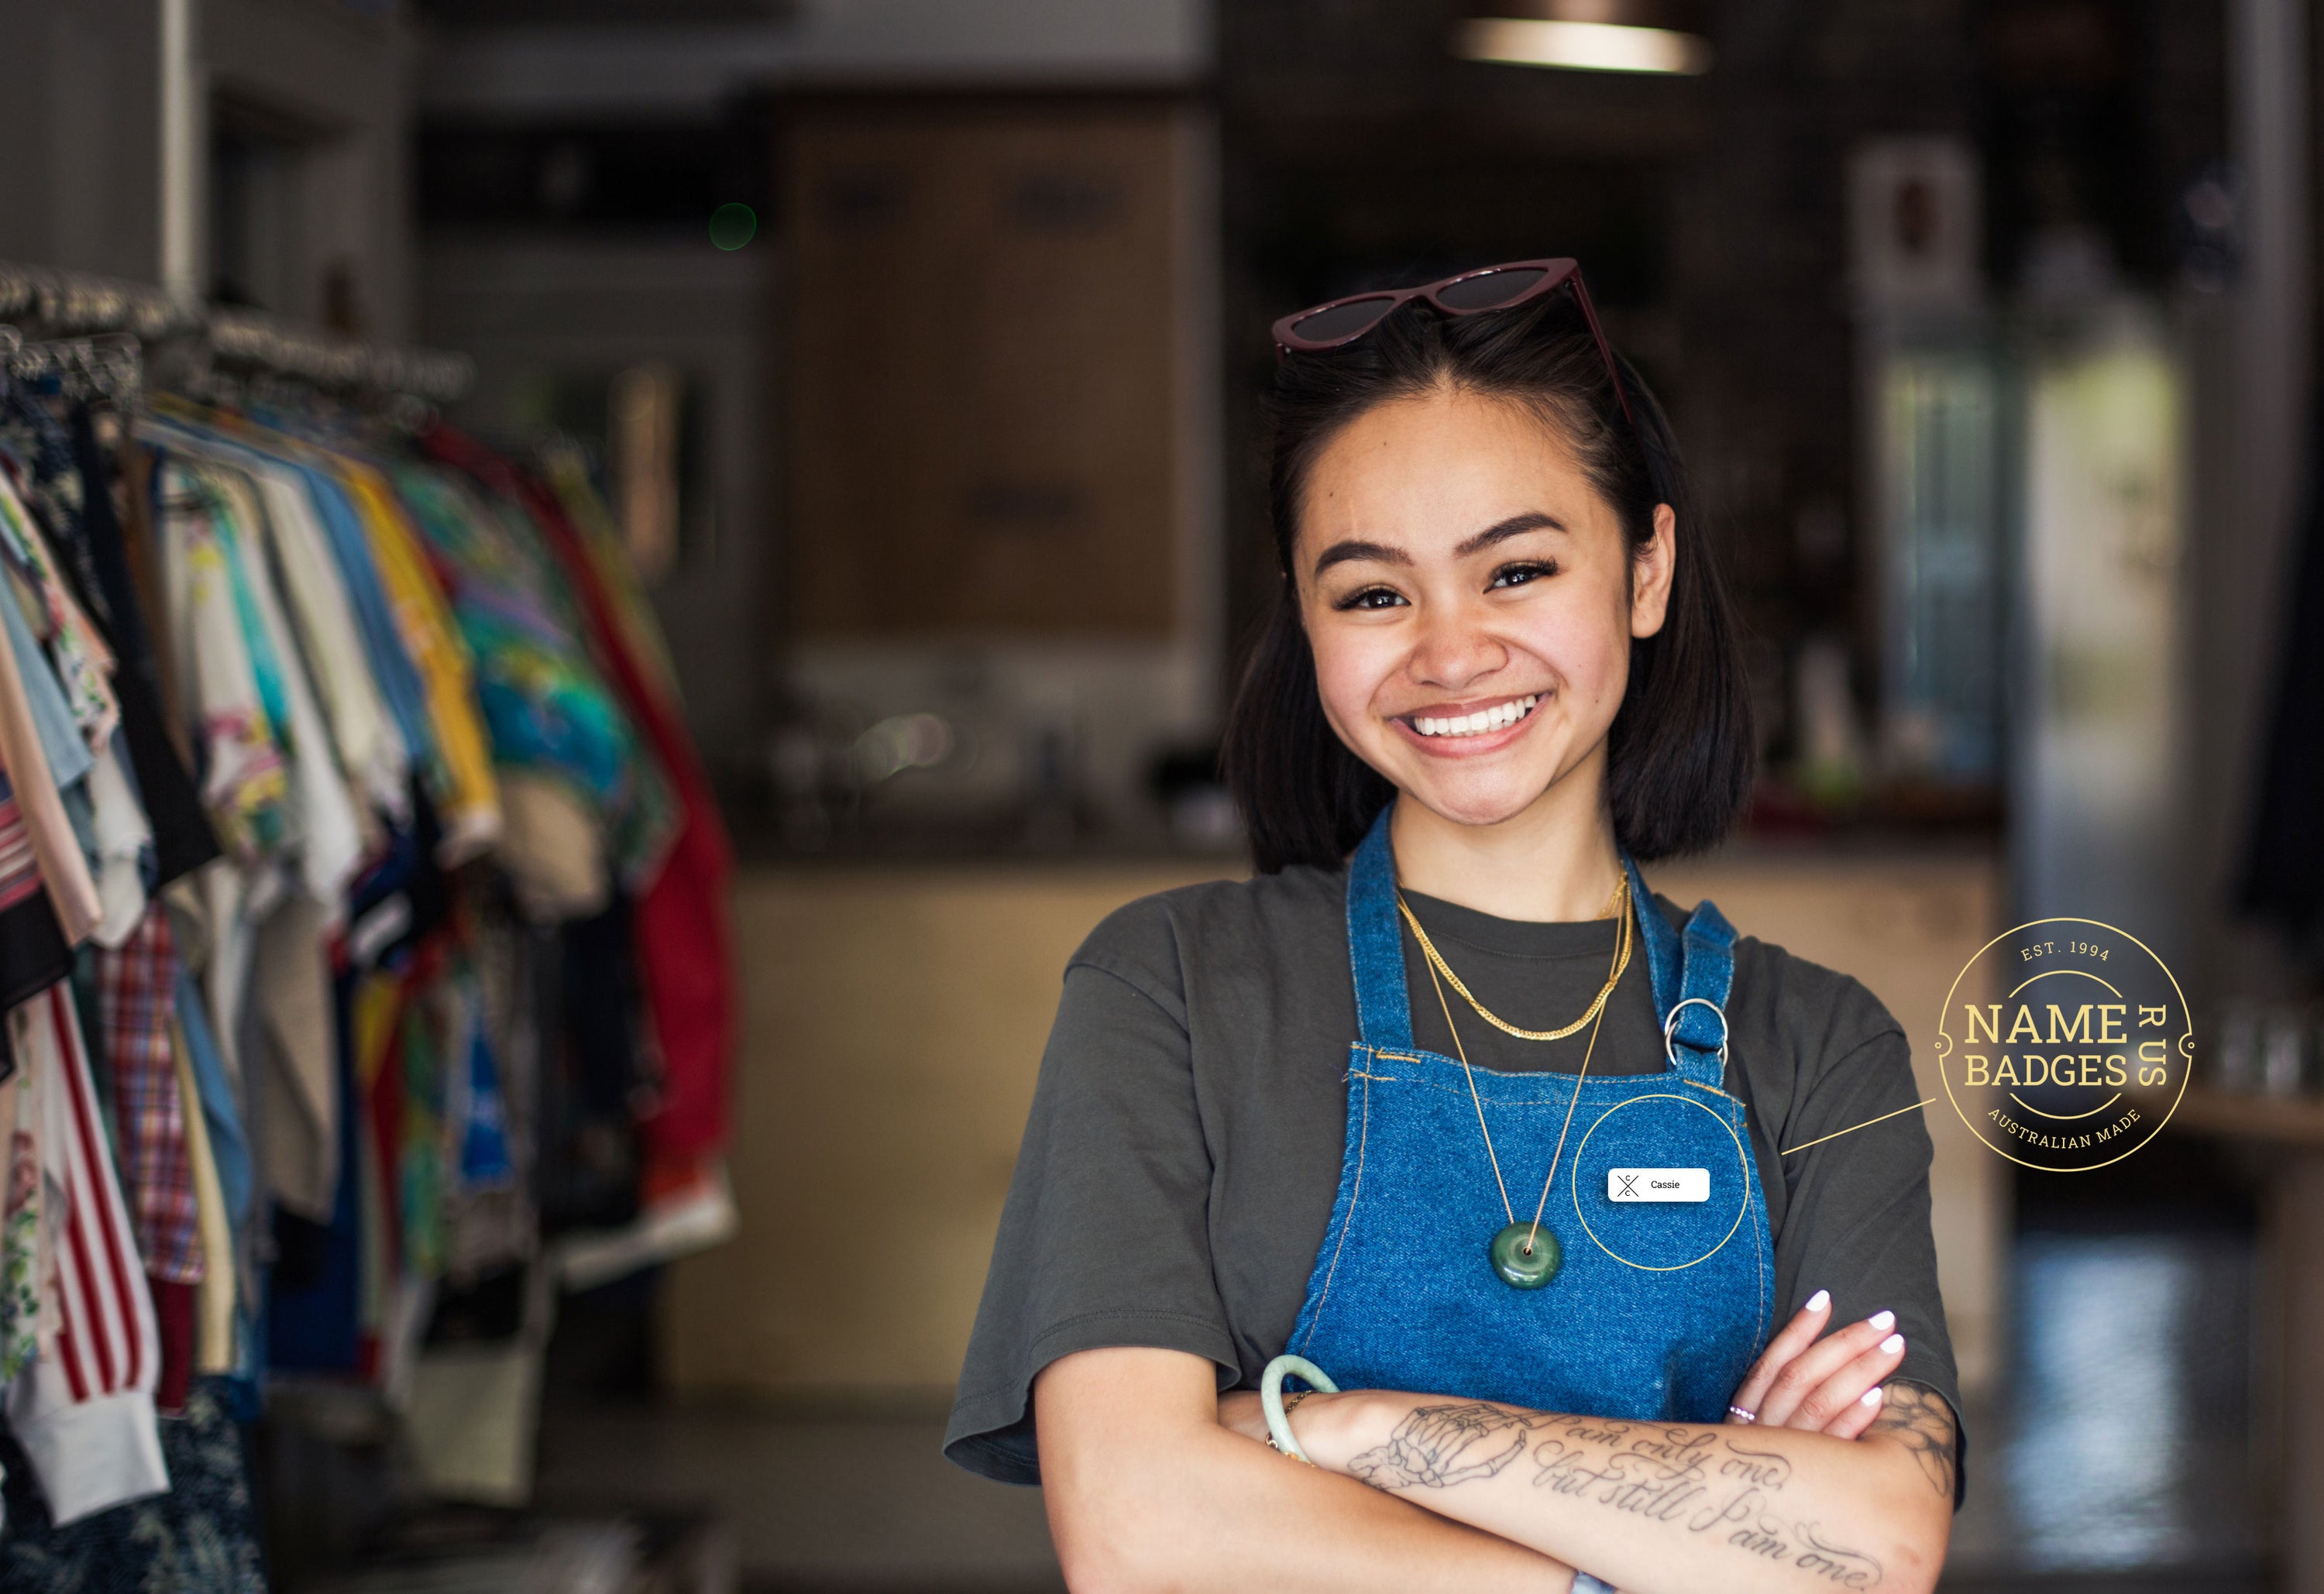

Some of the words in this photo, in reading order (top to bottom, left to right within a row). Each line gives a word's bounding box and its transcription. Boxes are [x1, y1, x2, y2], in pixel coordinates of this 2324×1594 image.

[1651, 1180, 1680, 1189] Cassie
[1566, 1427, 1621, 1448] am
[1627, 1427, 1718, 1481] only
[1533, 1442, 1624, 1497] but
[1598, 1479, 1707, 1521] still
[1728, 1528, 1789, 1560] am
